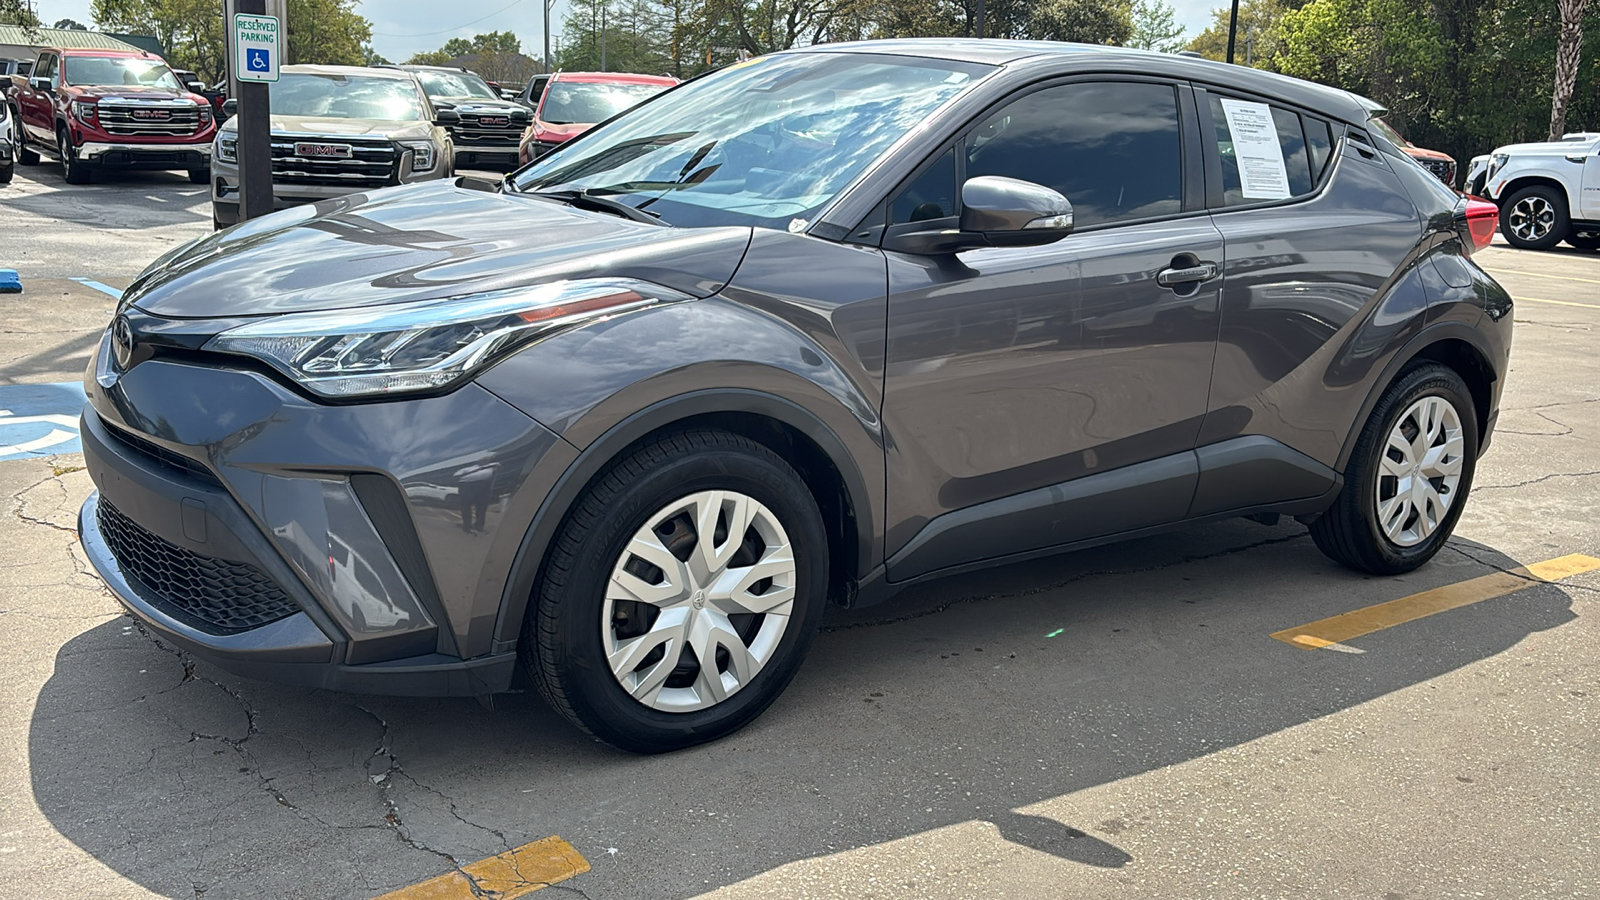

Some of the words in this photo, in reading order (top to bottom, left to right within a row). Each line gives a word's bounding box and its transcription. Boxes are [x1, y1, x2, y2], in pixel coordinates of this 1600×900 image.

[238, 20, 276, 32] RESERVED
[241, 32, 274, 43] PARKING
[133, 110, 170, 118] GMC
[297, 144, 348, 156] GMC
